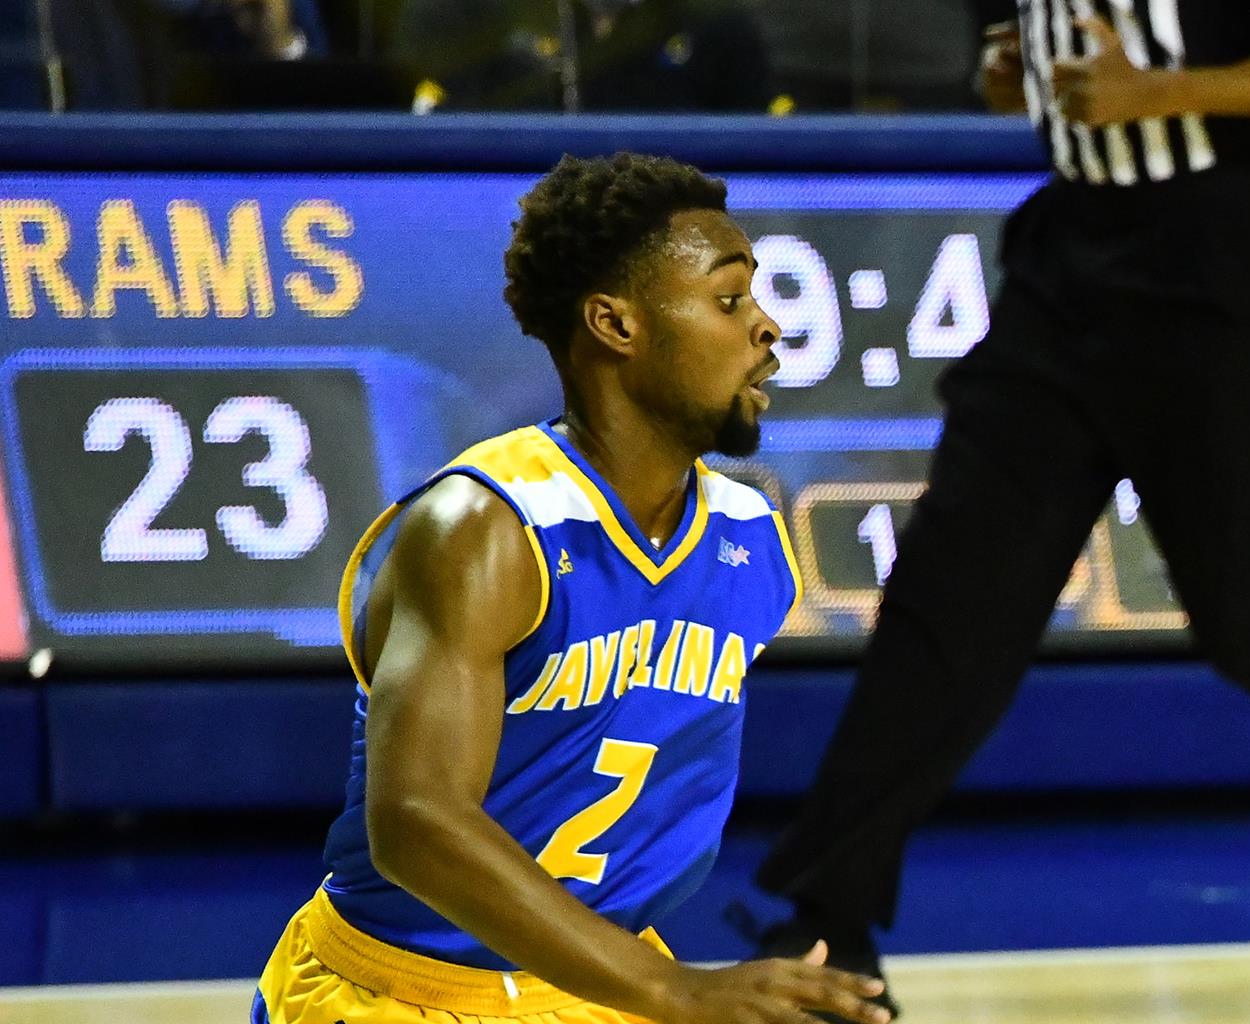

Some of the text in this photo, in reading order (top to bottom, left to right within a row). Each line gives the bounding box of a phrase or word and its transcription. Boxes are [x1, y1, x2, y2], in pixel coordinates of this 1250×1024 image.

[0, 198, 364, 319] RAMS
[750, 233, 990, 388] 9:4
[83, 396, 329, 562] 23
[506, 619, 766, 714] JAVELINA
[536, 737, 659, 885] 2
